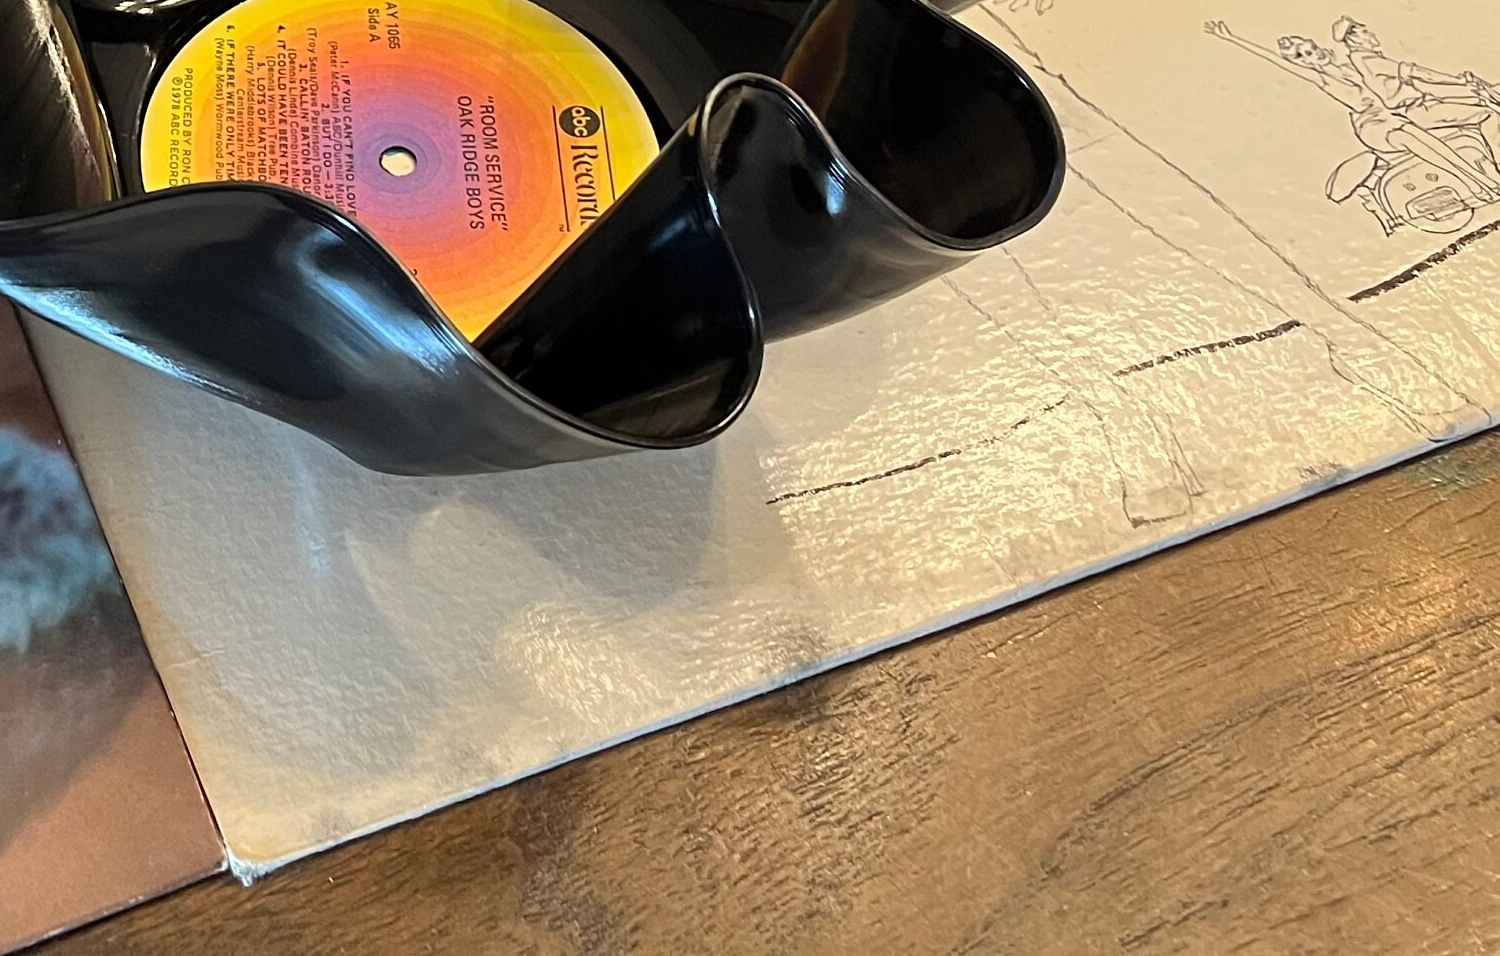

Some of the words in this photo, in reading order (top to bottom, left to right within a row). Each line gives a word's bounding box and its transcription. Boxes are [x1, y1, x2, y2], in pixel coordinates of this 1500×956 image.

[368, 7, 380, 31] Side
[385, 1, 398, 19] AY
[226, 25, 235, 33] 6.
[226, 38, 235, 50] IF
[276, 25, 286, 34] 4.
[307, 27, 318, 53] (Troy
[369, 33, 381, 43] A
[387, 22, 401, 50] 1065
[213, 37, 225, 71] (Wayne
[244, 45, 255, 74] (Harry
[276, 39, 287, 50] IT
[328, 40, 340, 68] (Peter
[226, 52, 235, 88] THERE
[256, 62, 266, 71] 5.
[266, 55, 277, 92] (Dennis
[277, 53, 288, 91] COULD
[287, 48, 298, 84] (Dennis
[298, 63, 308, 72] 3.
[341, 74, 350, 86] IF
[182, 67, 193, 127] PRODUCED
[214, 74, 225, 101] Moss)
[256, 77, 266, 105] LOTS
[308, 57, 320, 107] Seals/Dave
[329, 71, 341, 114] McCann)
[226, 90, 236, 124] WERE
[245, 77, 256, 148] Middlebrooks)
[266, 94, 278, 130] Wilson)
[278, 94, 288, 126] HAVE
[288, 87, 299, 118] Linde)
[299, 78, 310, 123] CALLIN'
[321, 103, 330, 112] 2.
[341, 89, 352, 112] YOU
[457, 95, 476, 129] OAK
[170, 113, 181, 136] ABC
[236, 88, 245, 152] Centerstream
[257, 108, 267, 124] OF
[321, 118, 332, 140] BUT
[479, 95, 498, 149] "ROOM
[572, 107, 591, 137] abc
[182, 130, 192, 145] BY
[214, 104, 225, 159] Wormwood
[226, 126, 236, 158] ONLY
[268, 133, 278, 155] Tree
[278, 129, 289, 159] BEEN
[290, 121, 300, 165] Combine
[300, 126, 311, 165] BATON
[309, 110, 321, 161] Parkinson)
[342, 117, 354, 150] CAN'T
[169, 139, 180, 186] RECORD
[182, 149, 192, 173] RON
[257, 127, 267, 182] MATCHBO
[323, 152, 333, 168] DO
[332, 117, 345, 180] ABC/Dunhill
[461, 134, 480, 183] RIDGE
[268, 158, 278, 179] Pub.
[279, 162, 289, 184] TEN
[302, 169, 312, 194] ROU
[344, 153, 355, 181] FIND
[345, 185, 358, 218] LOVE
[485, 151, 508, 232] SERVICE"
[466, 186, 485, 230] BOYS
